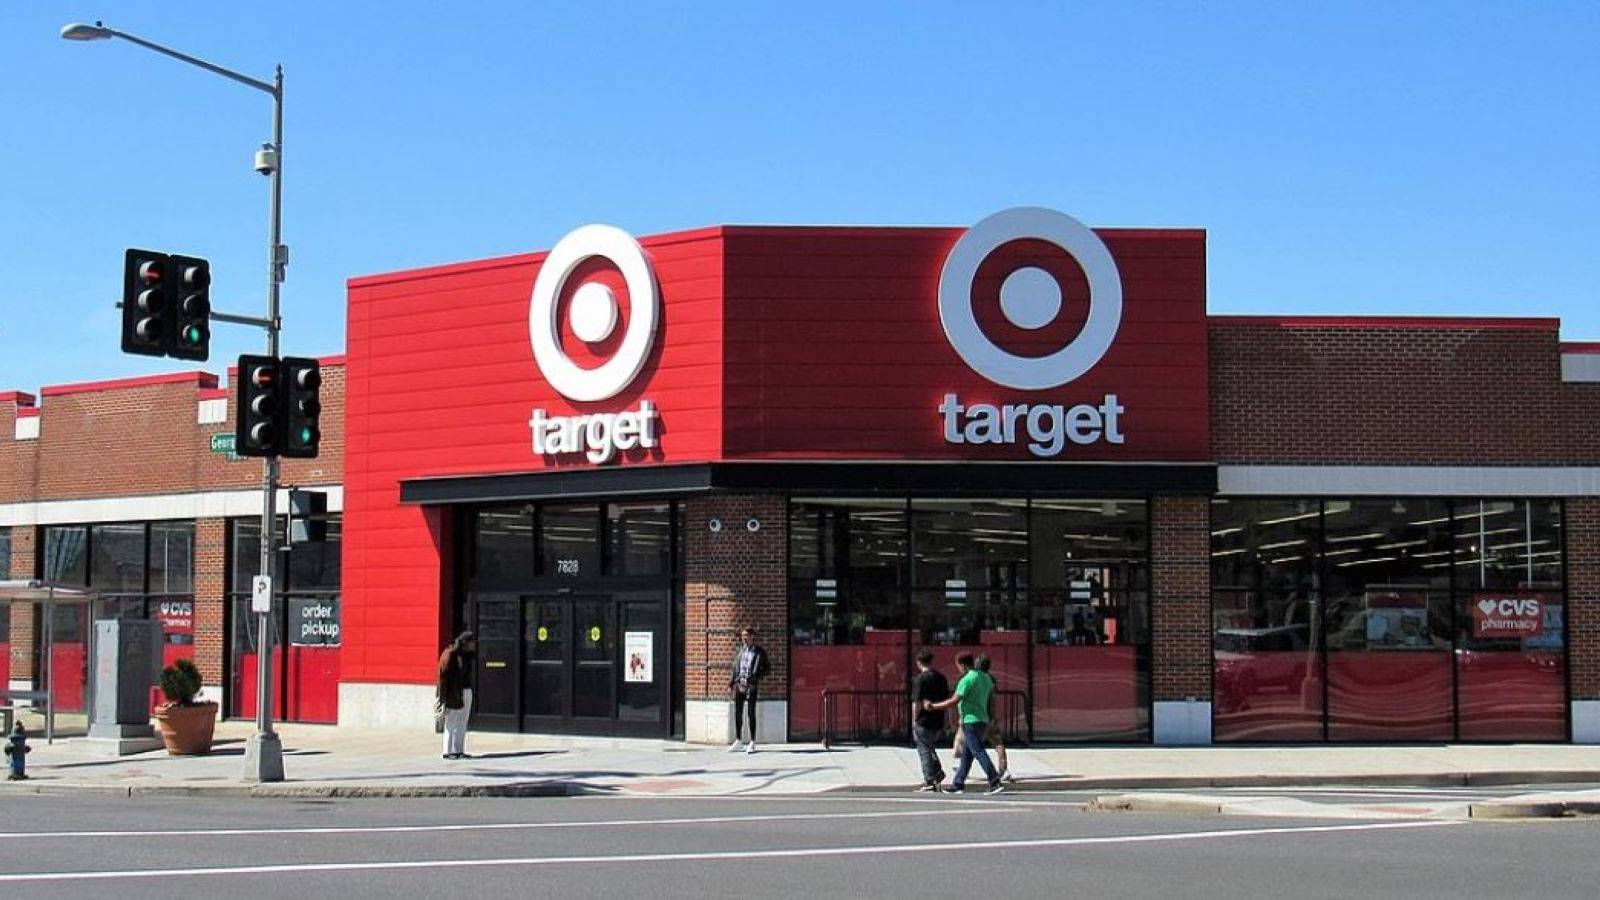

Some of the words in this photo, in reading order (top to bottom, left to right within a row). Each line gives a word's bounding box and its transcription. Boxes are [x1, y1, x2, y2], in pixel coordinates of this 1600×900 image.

[529, 400, 658, 464] target
[939, 393, 1124, 456] target
[170, 602, 192, 616] CVS
[301, 603, 332, 618] order
[1498, 599, 1539, 616] CVS
[301, 620, 339, 638] pickup
[1481, 618, 1538, 632] pharmacy
